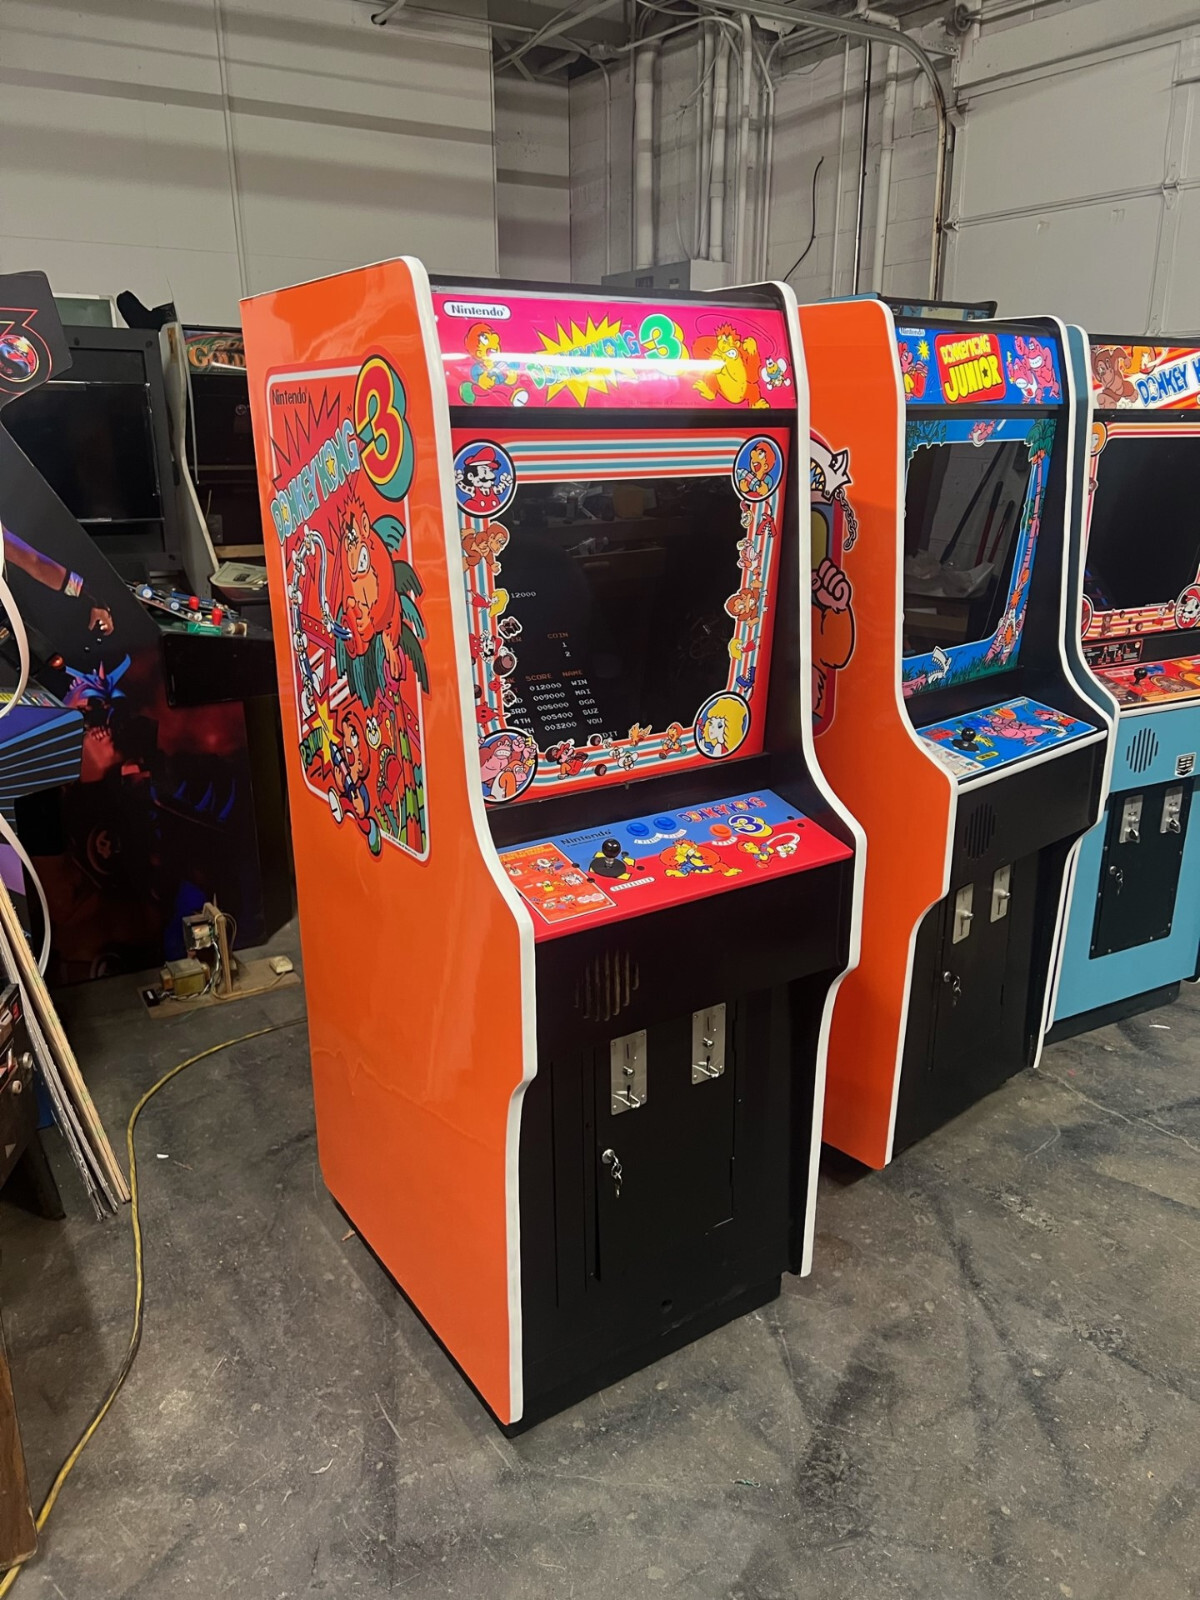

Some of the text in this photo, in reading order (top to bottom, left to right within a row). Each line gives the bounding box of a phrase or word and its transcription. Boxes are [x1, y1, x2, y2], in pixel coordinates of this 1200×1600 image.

[450, 304, 505, 317] Nintendo
[638, 313, 689, 374] 3
[939, 334, 991, 365] DONKEY KONG
[944, 355, 1003, 402] JUNIOR
[1135, 361, 1190, 408] DONKEY
[272, 388, 307, 406] Nintendo
[353, 354, 415, 502] 3
[270, 418, 361, 545] DONKEY KONG
[525, 673, 553, 682] SCORE
[562, 669, 583, 677] NAME
[529, 682, 562, 692] 012000
[571, 679, 588, 687] WIN
[533, 692, 566, 701] 009000
[575, 688, 592, 696] MAI
[510, 707, 527, 715] 3RD
[513, 717, 532, 725] 4TH
[541, 711, 574, 721] 005400
[544, 721, 578, 731] 003200
[587, 717, 603, 725] YOU
[677, 796, 767, 825] DONKEY KONG
[728, 814, 773, 837] 3
[560, 829, 612, 845] Nintendo
